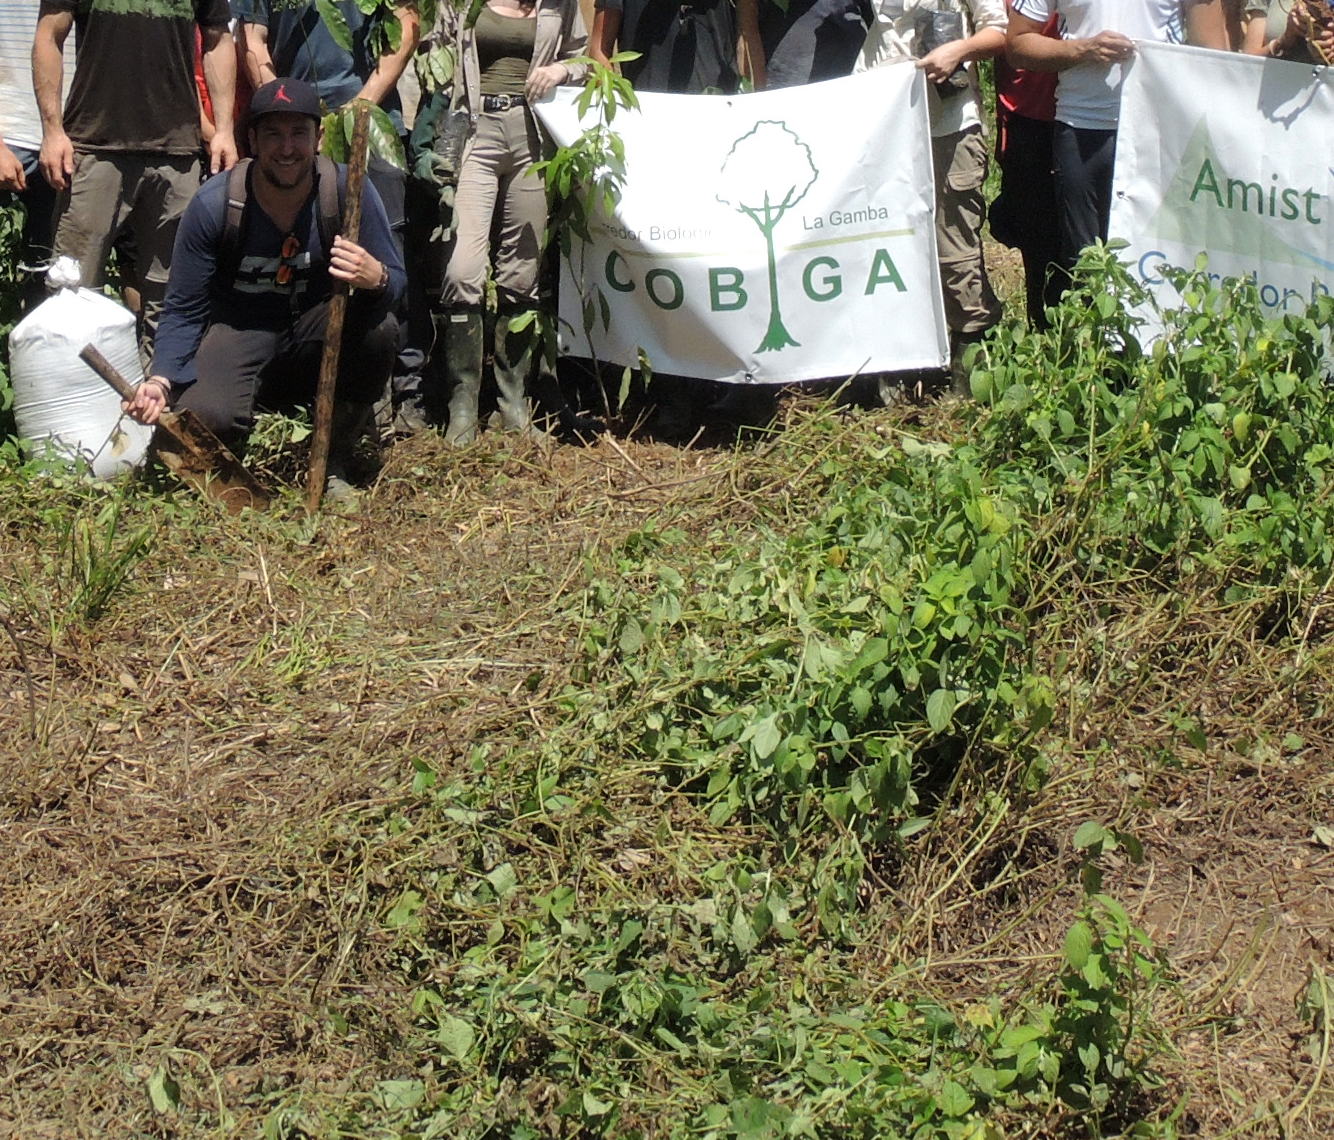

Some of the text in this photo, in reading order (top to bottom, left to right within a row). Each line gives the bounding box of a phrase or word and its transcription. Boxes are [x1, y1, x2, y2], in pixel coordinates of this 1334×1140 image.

[1188, 157, 1322, 225] Amist
[802, 205, 889, 231] La Gamba
